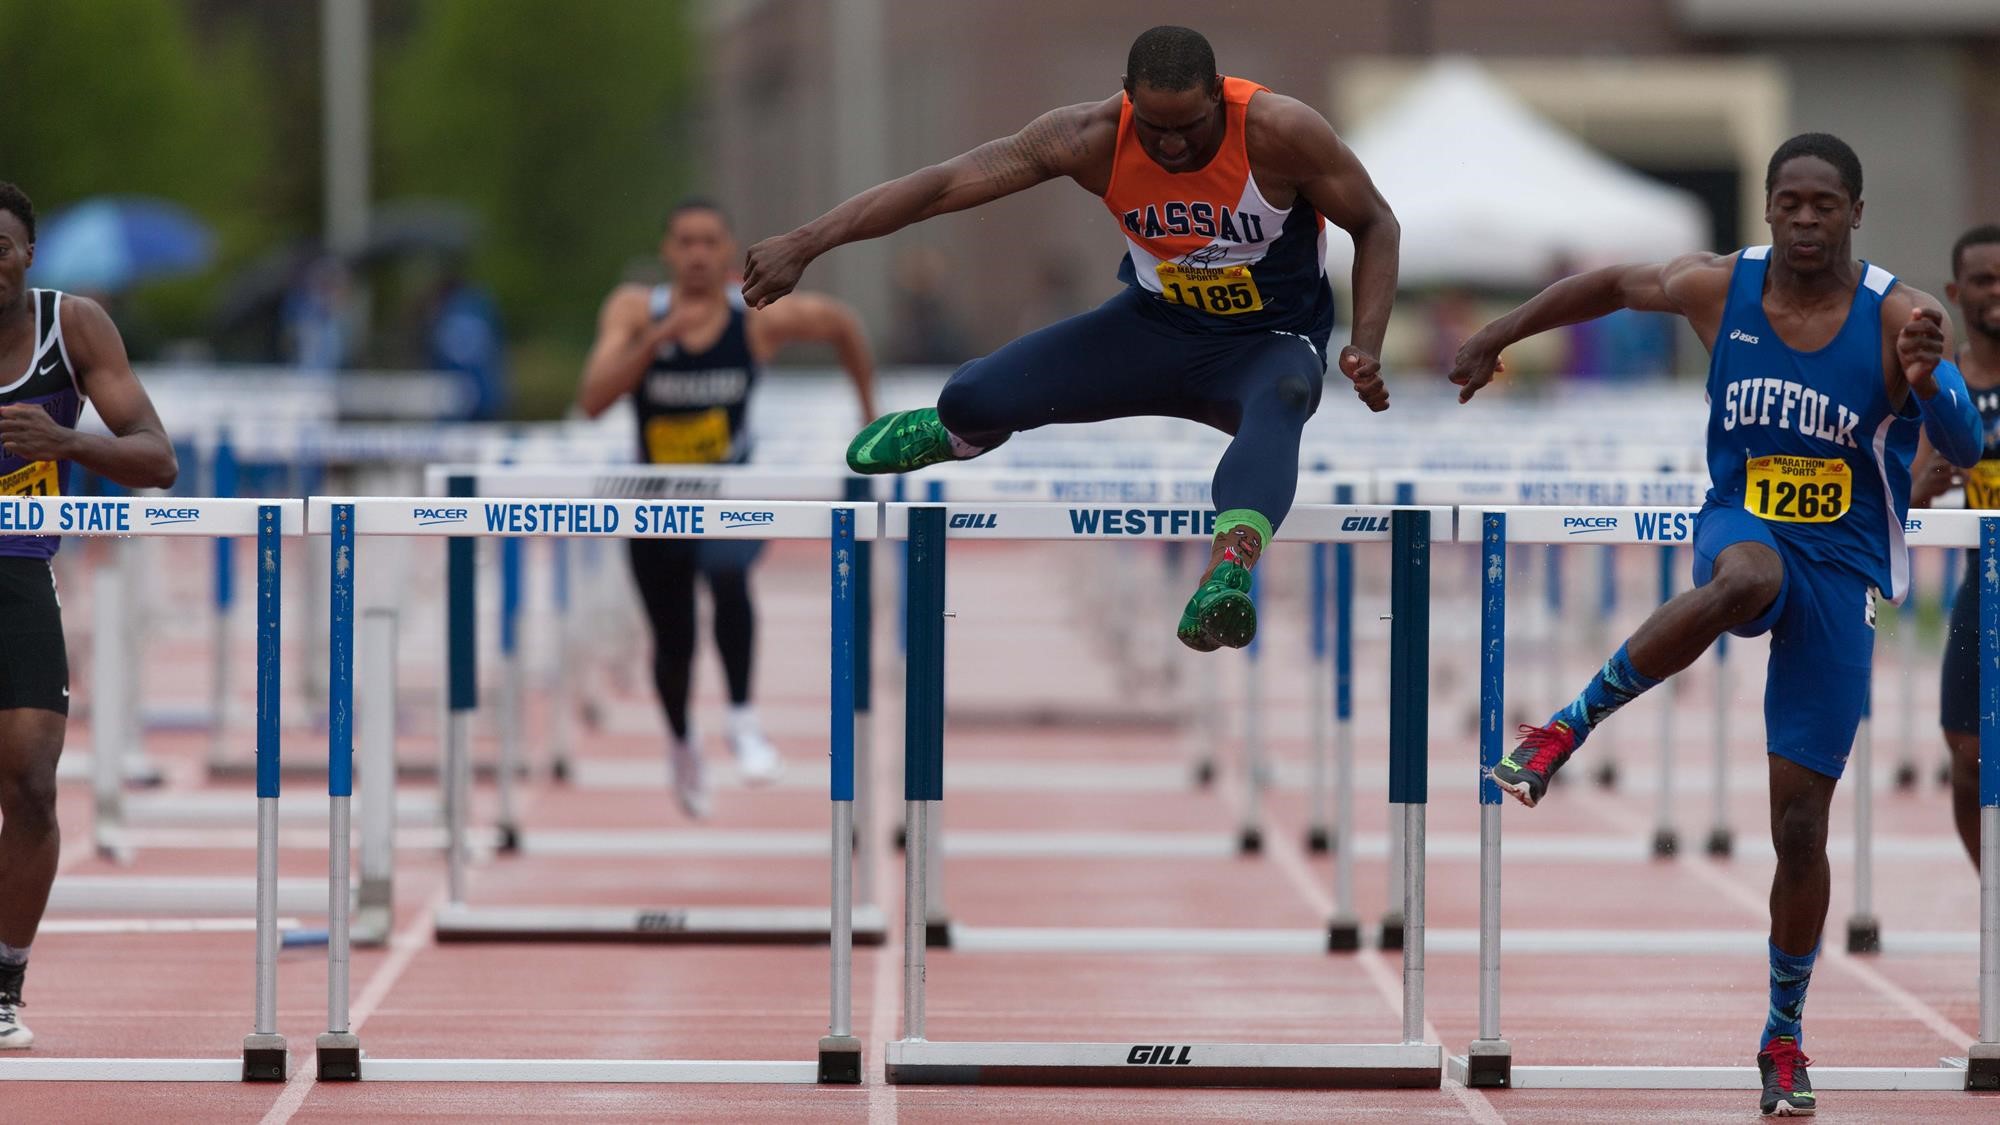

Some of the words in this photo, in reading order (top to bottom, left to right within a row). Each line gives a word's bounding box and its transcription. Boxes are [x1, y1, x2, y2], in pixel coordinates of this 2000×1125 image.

[1176, 266, 1224, 276] MARATHON
[1168, 282, 1253, 312] 1185
[1723, 377, 1860, 449] SUFFOLK
[1773, 457, 1825, 468] MARATHON
[1781, 466, 1816, 476] SPORTS
[1756, 478, 1843, 518] 1263
[60, 503, 130, 531] STATE
[145, 508, 199, 519] PACER
[413, 508, 468, 519] PACER
[484, 503, 619, 533] WESTFIELD
[634, 505, 705, 534] STATE
[720, 511, 774, 522] PACER
[949, 513, 997, 528] GILL
[1341, 516, 1390, 531] GILL
[1563, 517, 1618, 528] PACER
[1126, 1045, 1192, 1065] GILL
